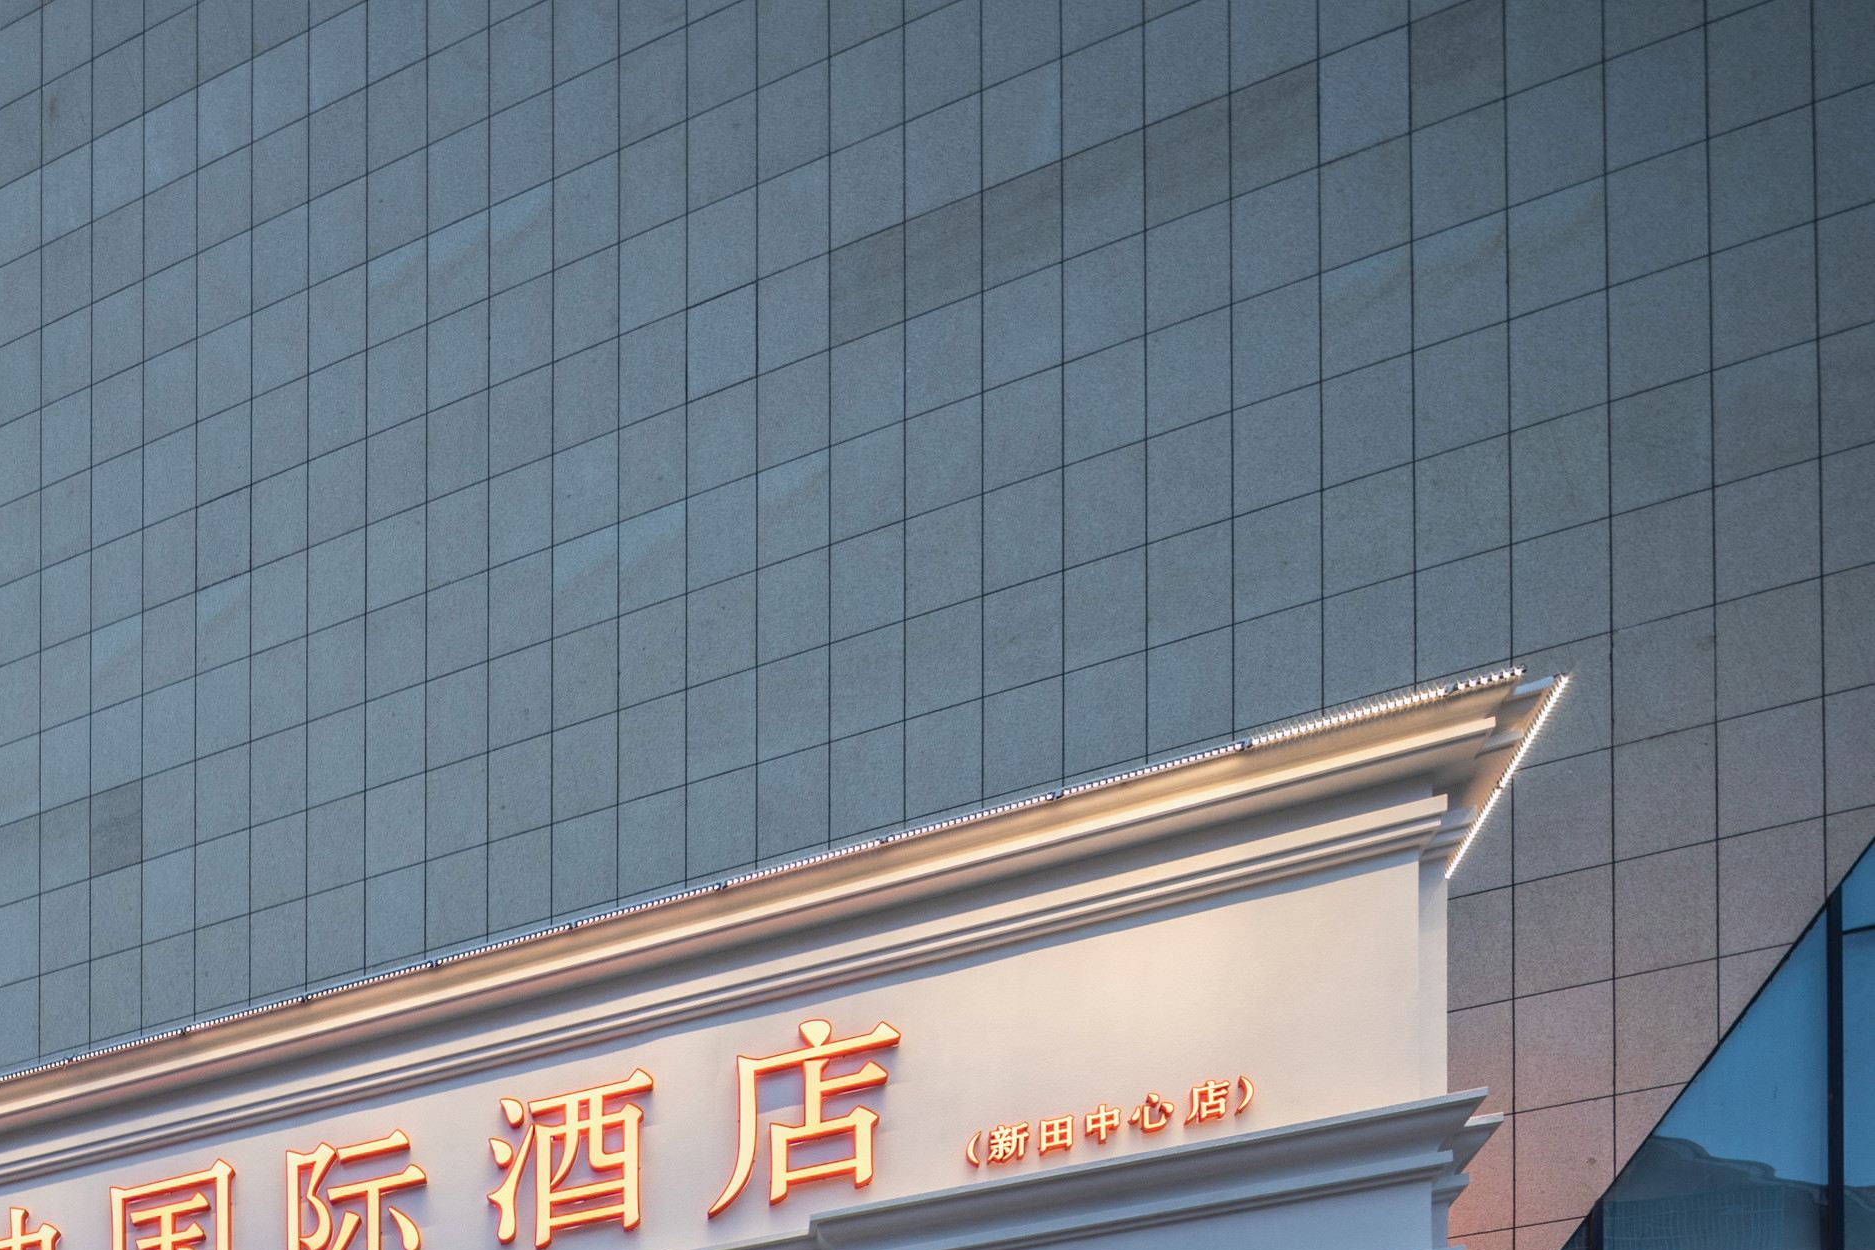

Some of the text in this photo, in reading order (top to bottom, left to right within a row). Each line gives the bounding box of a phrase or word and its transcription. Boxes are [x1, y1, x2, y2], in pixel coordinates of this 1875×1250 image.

[966, 1075, 1255, 1168] （新田中心店）
